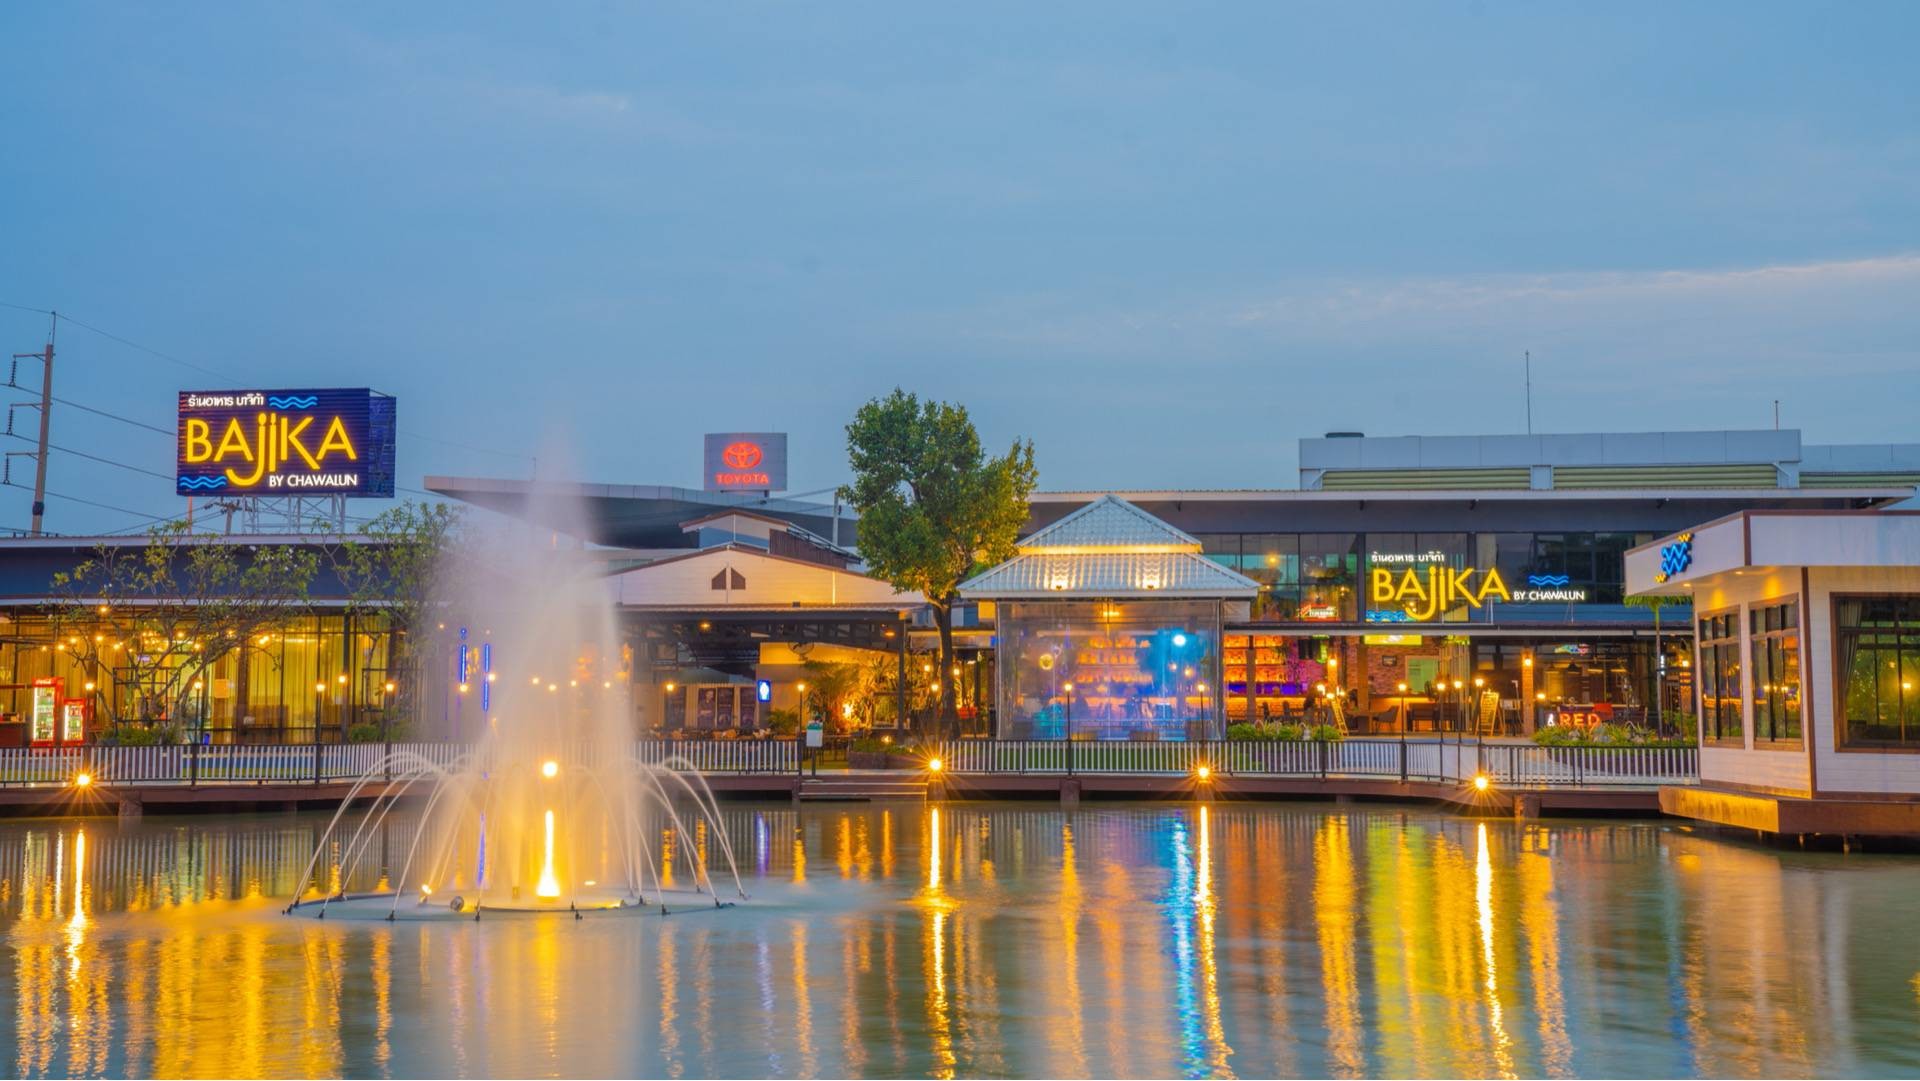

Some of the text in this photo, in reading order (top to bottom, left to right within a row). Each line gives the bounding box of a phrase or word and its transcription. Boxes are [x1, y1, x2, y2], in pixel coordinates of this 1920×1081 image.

[188, 395, 234, 407] ร้านอาหาร
[269, 473, 358, 487] BY CHAWALUN
[716, 473, 769, 485] TOYOTA
[1371, 551, 1414, 562] ร้านอาหาร
[1513, 591, 1585, 600] BY CHAWALUN
